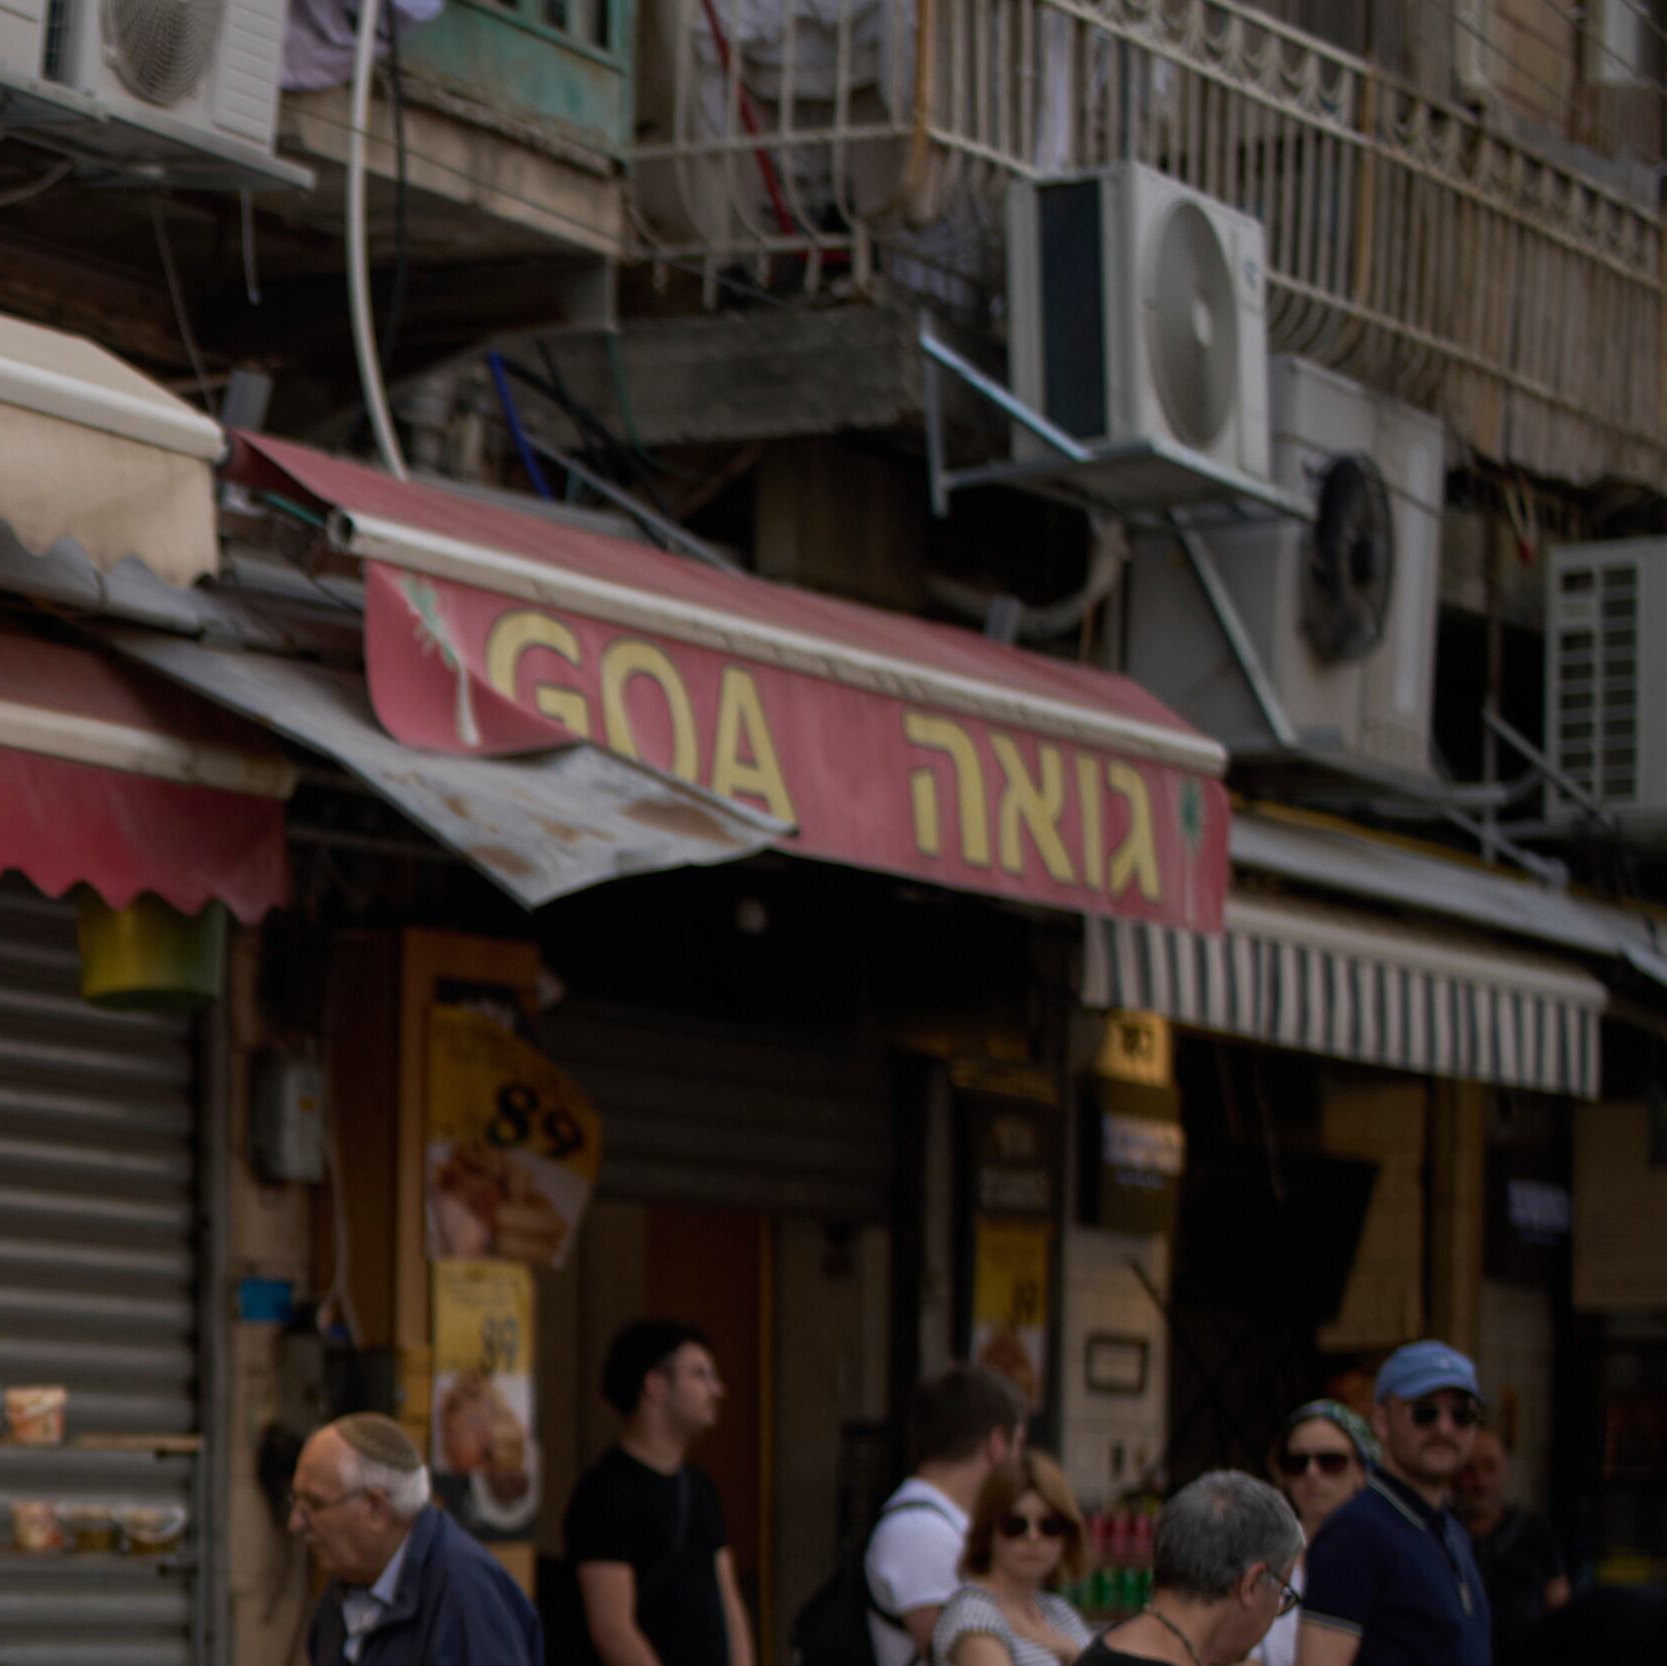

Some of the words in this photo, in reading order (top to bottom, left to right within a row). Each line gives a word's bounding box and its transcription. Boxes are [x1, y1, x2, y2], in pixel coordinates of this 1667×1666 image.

[483, 610, 797, 835] GOA
[902, 711, 1166, 906] גואה
[483, 1079, 586, 1162] 89
